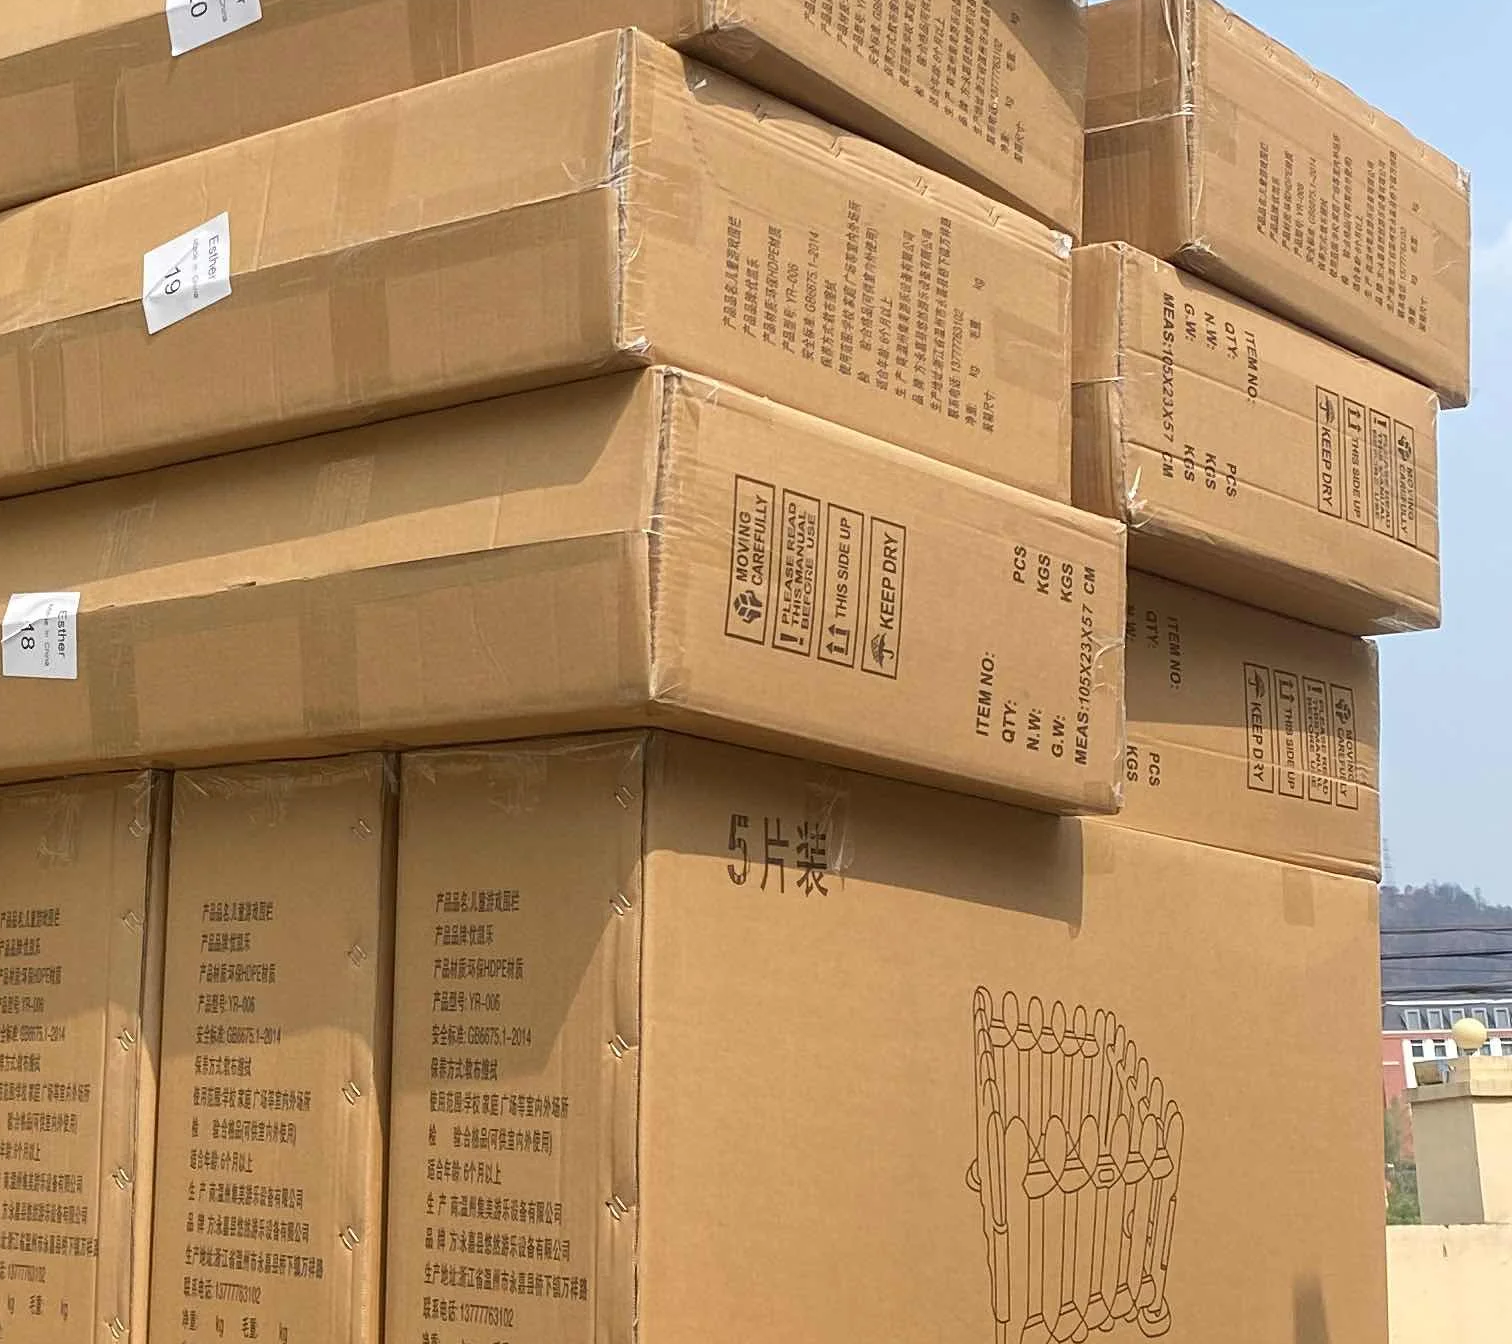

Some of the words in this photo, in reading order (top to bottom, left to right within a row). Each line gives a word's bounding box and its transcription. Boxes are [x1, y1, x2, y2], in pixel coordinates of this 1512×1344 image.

[208, 235, 219, 280] Esther
[164, 267, 180, 294] 19
[1184, 303, 1195, 342] G.W:
[1204, 312, 1217, 351] N.W:
[1224, 322, 1238, 359] QTY:
[1244, 331, 1258, 371] ITEM
[1248, 373, 1258, 404] NO:
[1162, 451, 1174, 479] CM
[1183, 443, 1195, 482] KGS
[1321, 427, 1331, 471] KEEP
[1204, 452, 1216, 490] KGS
[1225, 462, 1238, 497] PCS
[1322, 473, 1332, 508] DRY
[736, 511, 752, 582] MOVING
[751, 494, 768, 587] CAREFULLY
[787, 502, 797, 552] READ
[840, 517, 851, 541] UP
[794, 511, 807, 584] MANUAL
[837, 544, 849, 579] SIDE
[884, 533, 899, 571] DRY
[782, 555, 794, 625] PLEASE
[801, 557, 813, 630] BEFORE
[807, 514, 816, 549] USE
[1082, 567, 1096, 595] CM
[791, 588, 802, 626] THIS
[834, 582, 847, 618] THIS
[879, 574, 896, 630] KEEP
[20, 624, 35, 650] 18
[58, 610, 67, 657] Esther
[1002, 700, 1017, 743] QTY:
[1013, 545, 1028, 584] PCS
[1146, 610, 1158, 649] QTY:
[1167, 617, 1180, 656] ITEM
[981, 651, 996, 686] NO:
[1027, 708, 1042, 750] N.W:
[1037, 554, 1051, 595] KGS
[1051, 715, 1066, 758] G.W:
[1060, 562, 1074, 603] KGS
[1170, 660, 1181, 690] NO:
[976, 687, 991, 737] ITEM
[1251, 702, 1263, 745] KEEP
[1127, 745, 1137, 782] KGS
[1149, 752, 1161, 787] PCS
[1253, 749, 1264, 782] DRY
[728, 813, 827, 897] 5片装
